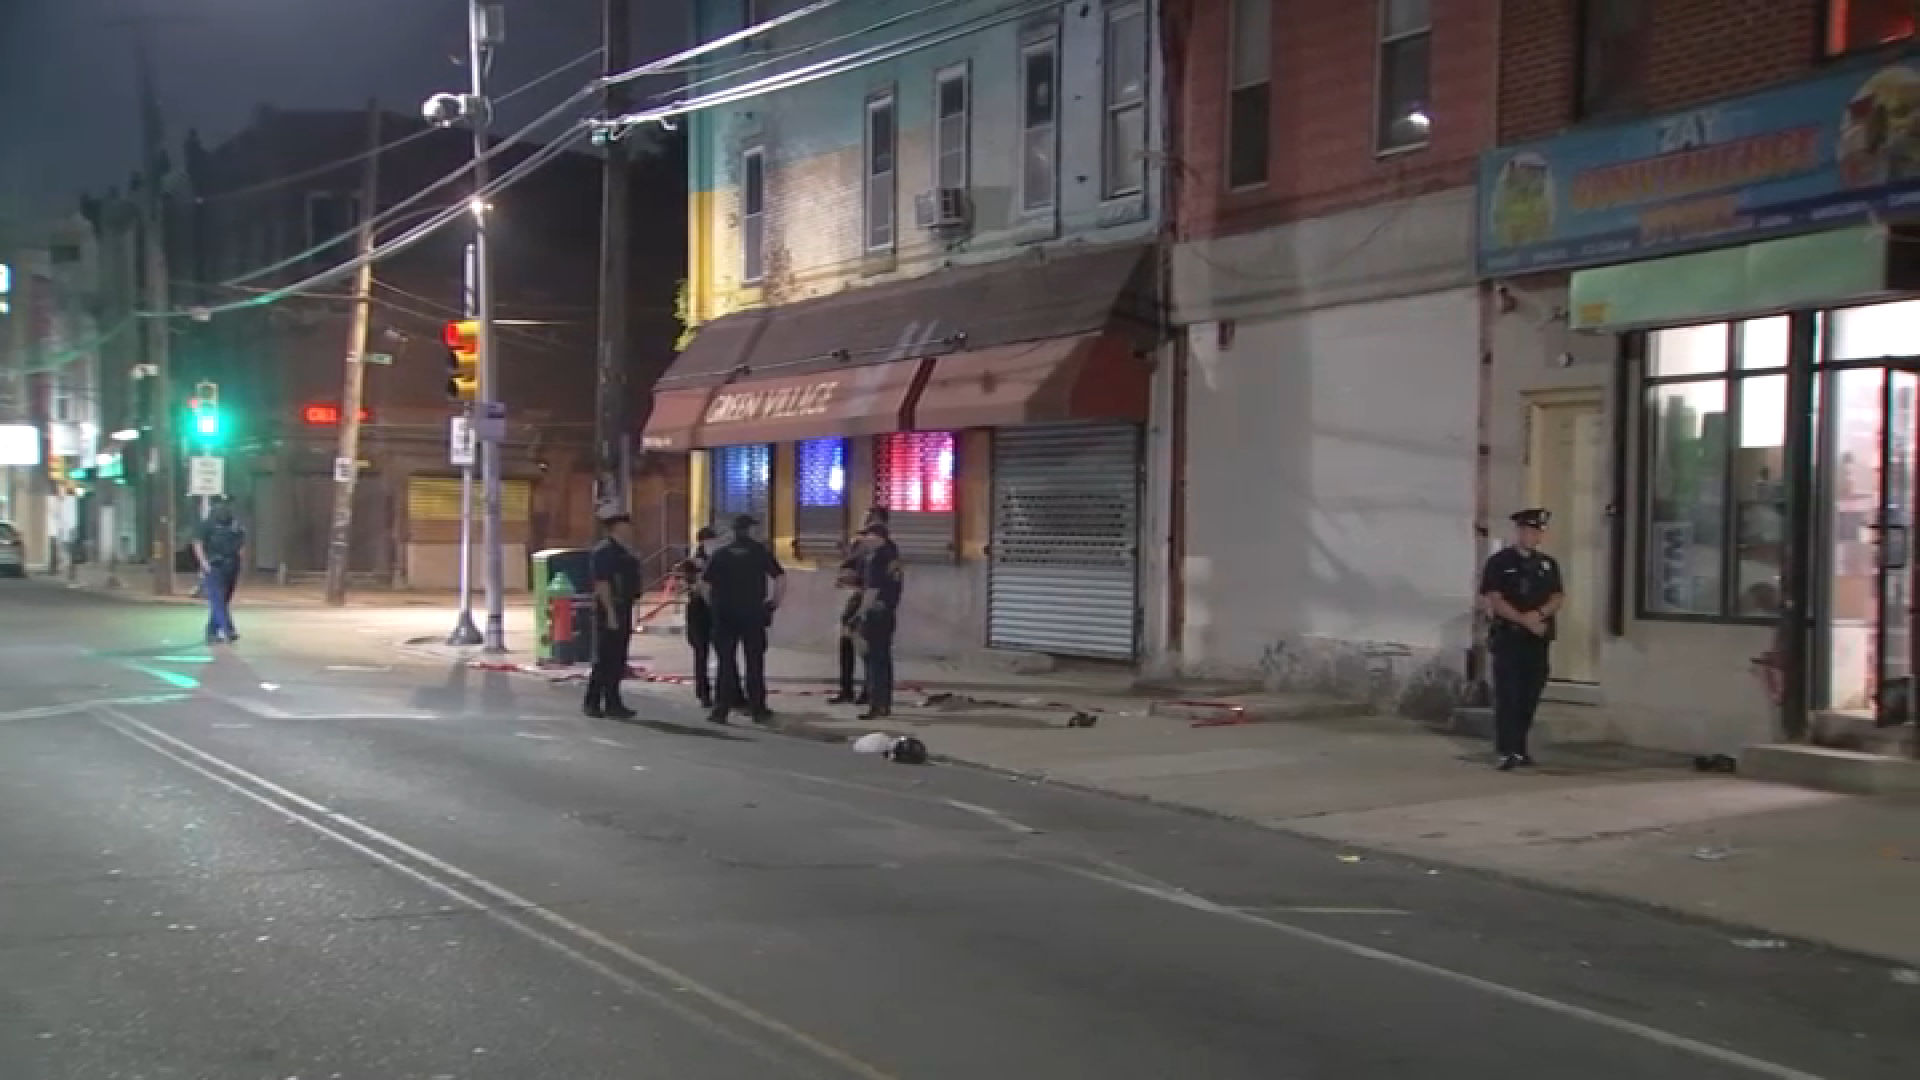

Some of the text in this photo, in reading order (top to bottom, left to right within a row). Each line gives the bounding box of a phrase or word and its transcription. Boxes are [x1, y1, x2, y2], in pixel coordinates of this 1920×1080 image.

[706, 381, 838, 422] GREEN VILLAGE
[1663, 527, 1684, 609] ATM
